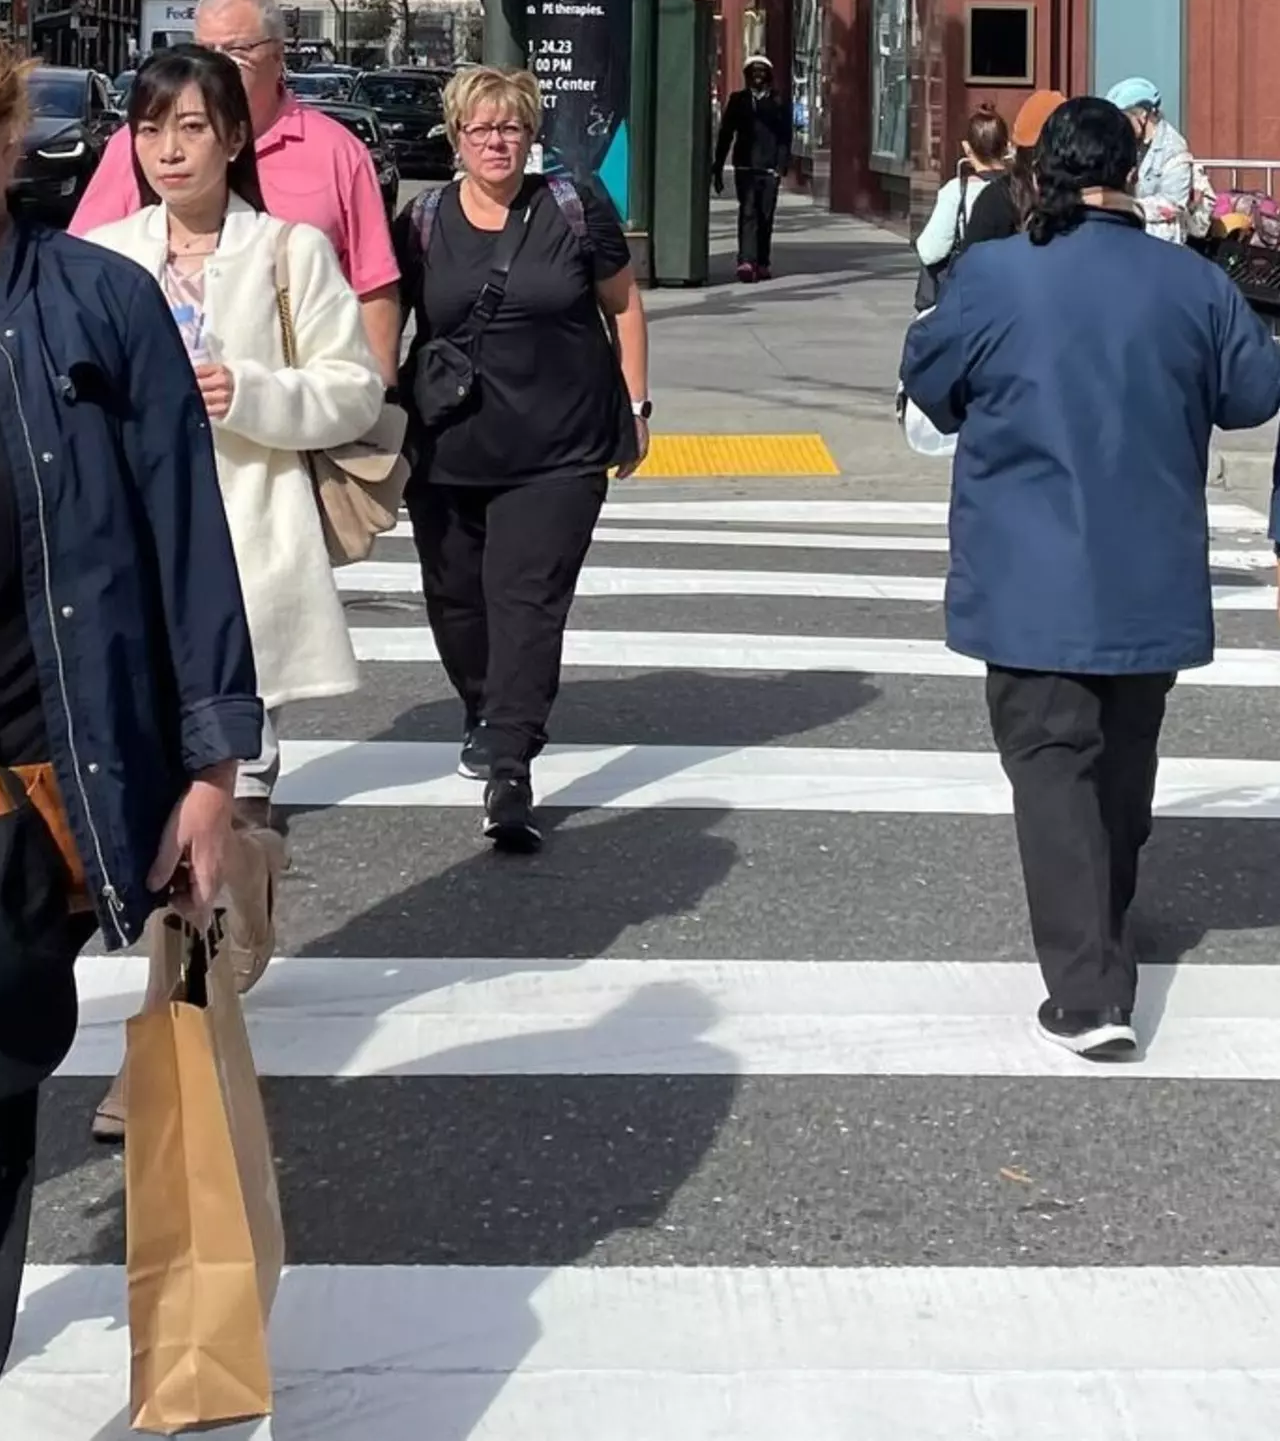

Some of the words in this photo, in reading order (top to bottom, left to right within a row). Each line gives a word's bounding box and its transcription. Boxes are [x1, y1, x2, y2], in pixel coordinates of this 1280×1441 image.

[166, 6, 195, 20] FedE
[555, 3, 605, 17] therapies.
[528, 39, 572, 54] 1.24.23
[552, 58, 572, 72] PM
[555, 77, 597, 91] Center
